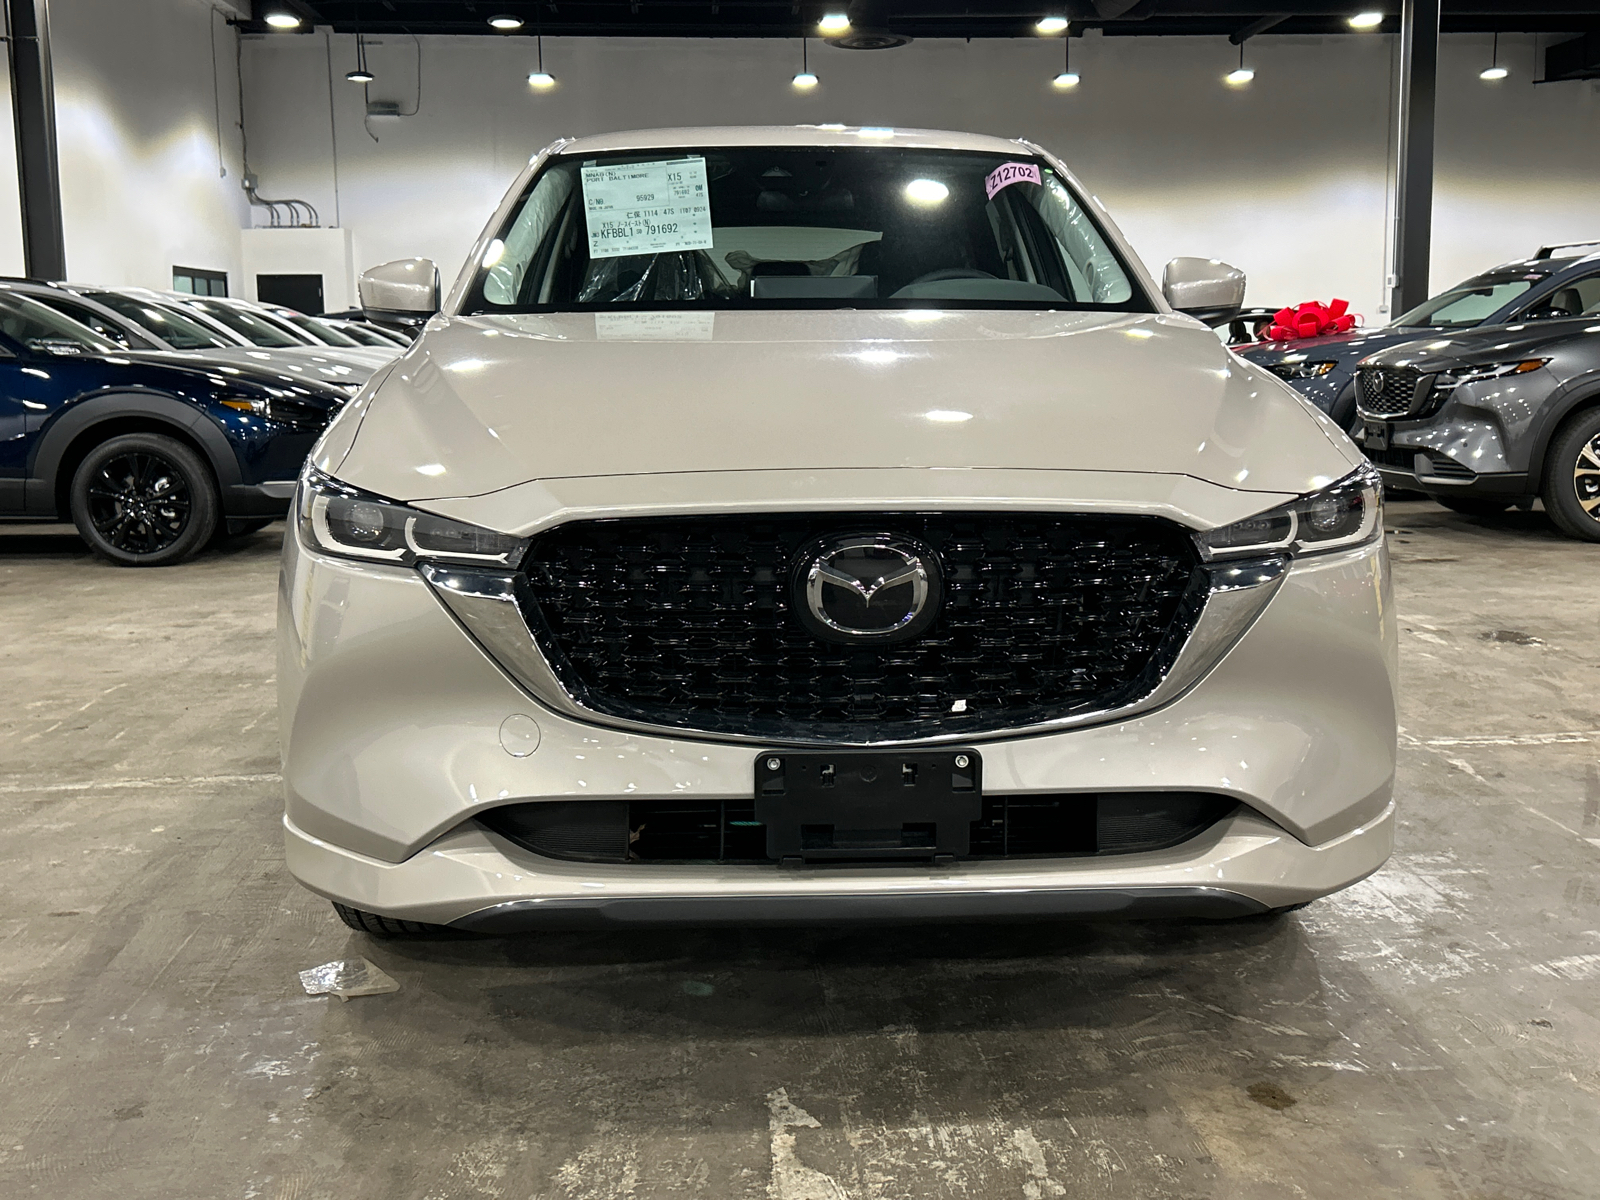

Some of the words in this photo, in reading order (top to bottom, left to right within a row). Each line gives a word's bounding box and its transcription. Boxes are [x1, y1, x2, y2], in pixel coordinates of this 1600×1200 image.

[609, 173, 649, 181] BALTIMORE
[667, 172, 682, 181] X15
[990, 166, 1034, 190] Z12702
[636, 194, 655, 202] 95929
[602, 221, 614, 229] X15
[600, 227, 633, 239] KFBBL1
[645, 223, 678, 235] 791692
